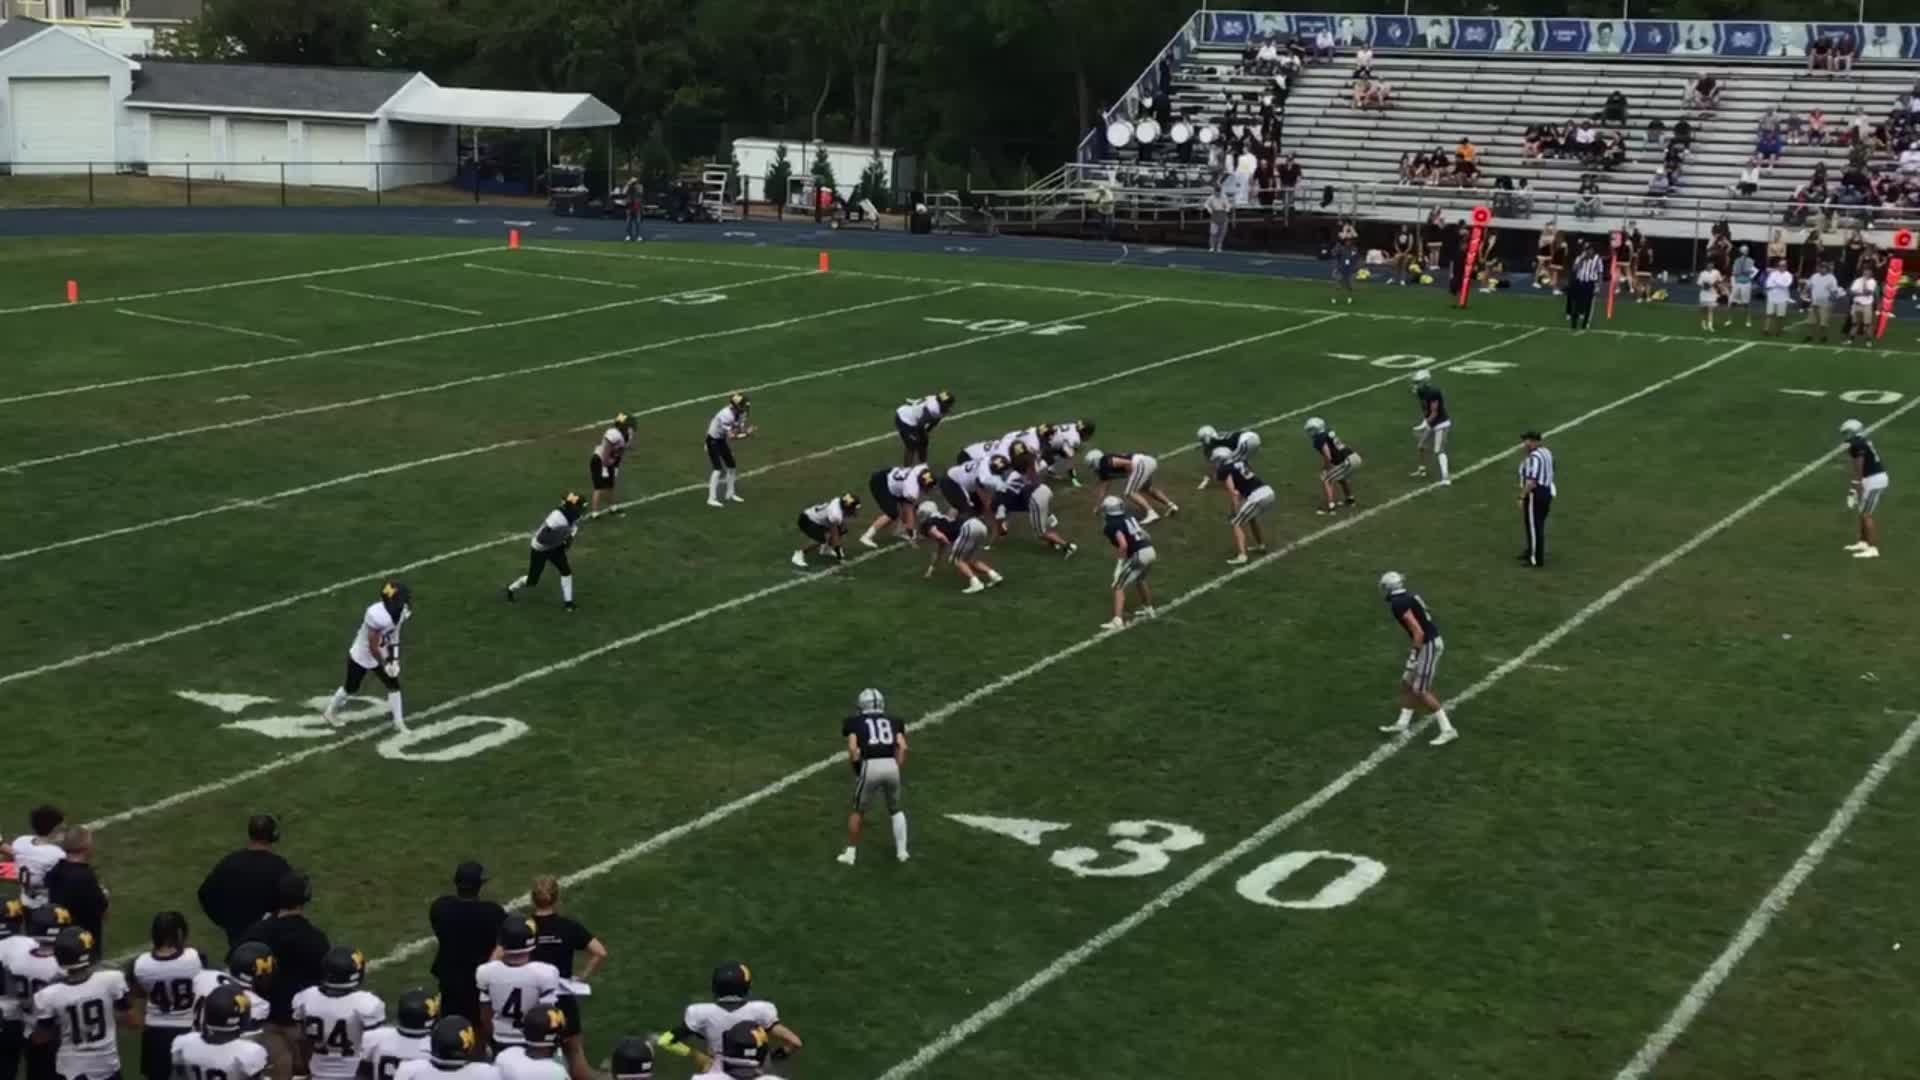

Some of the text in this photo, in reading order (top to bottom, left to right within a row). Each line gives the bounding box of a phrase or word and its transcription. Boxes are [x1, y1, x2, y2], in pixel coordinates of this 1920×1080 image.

[865, 717, 895, 745] 18
[1049, 818, 1388, 909] 30
[149, 979, 195, 1013] 48
[501, 986, 524, 1028] 4
[66, 998, 107, 1045] 19
[304, 1015, 356, 1057] 24
